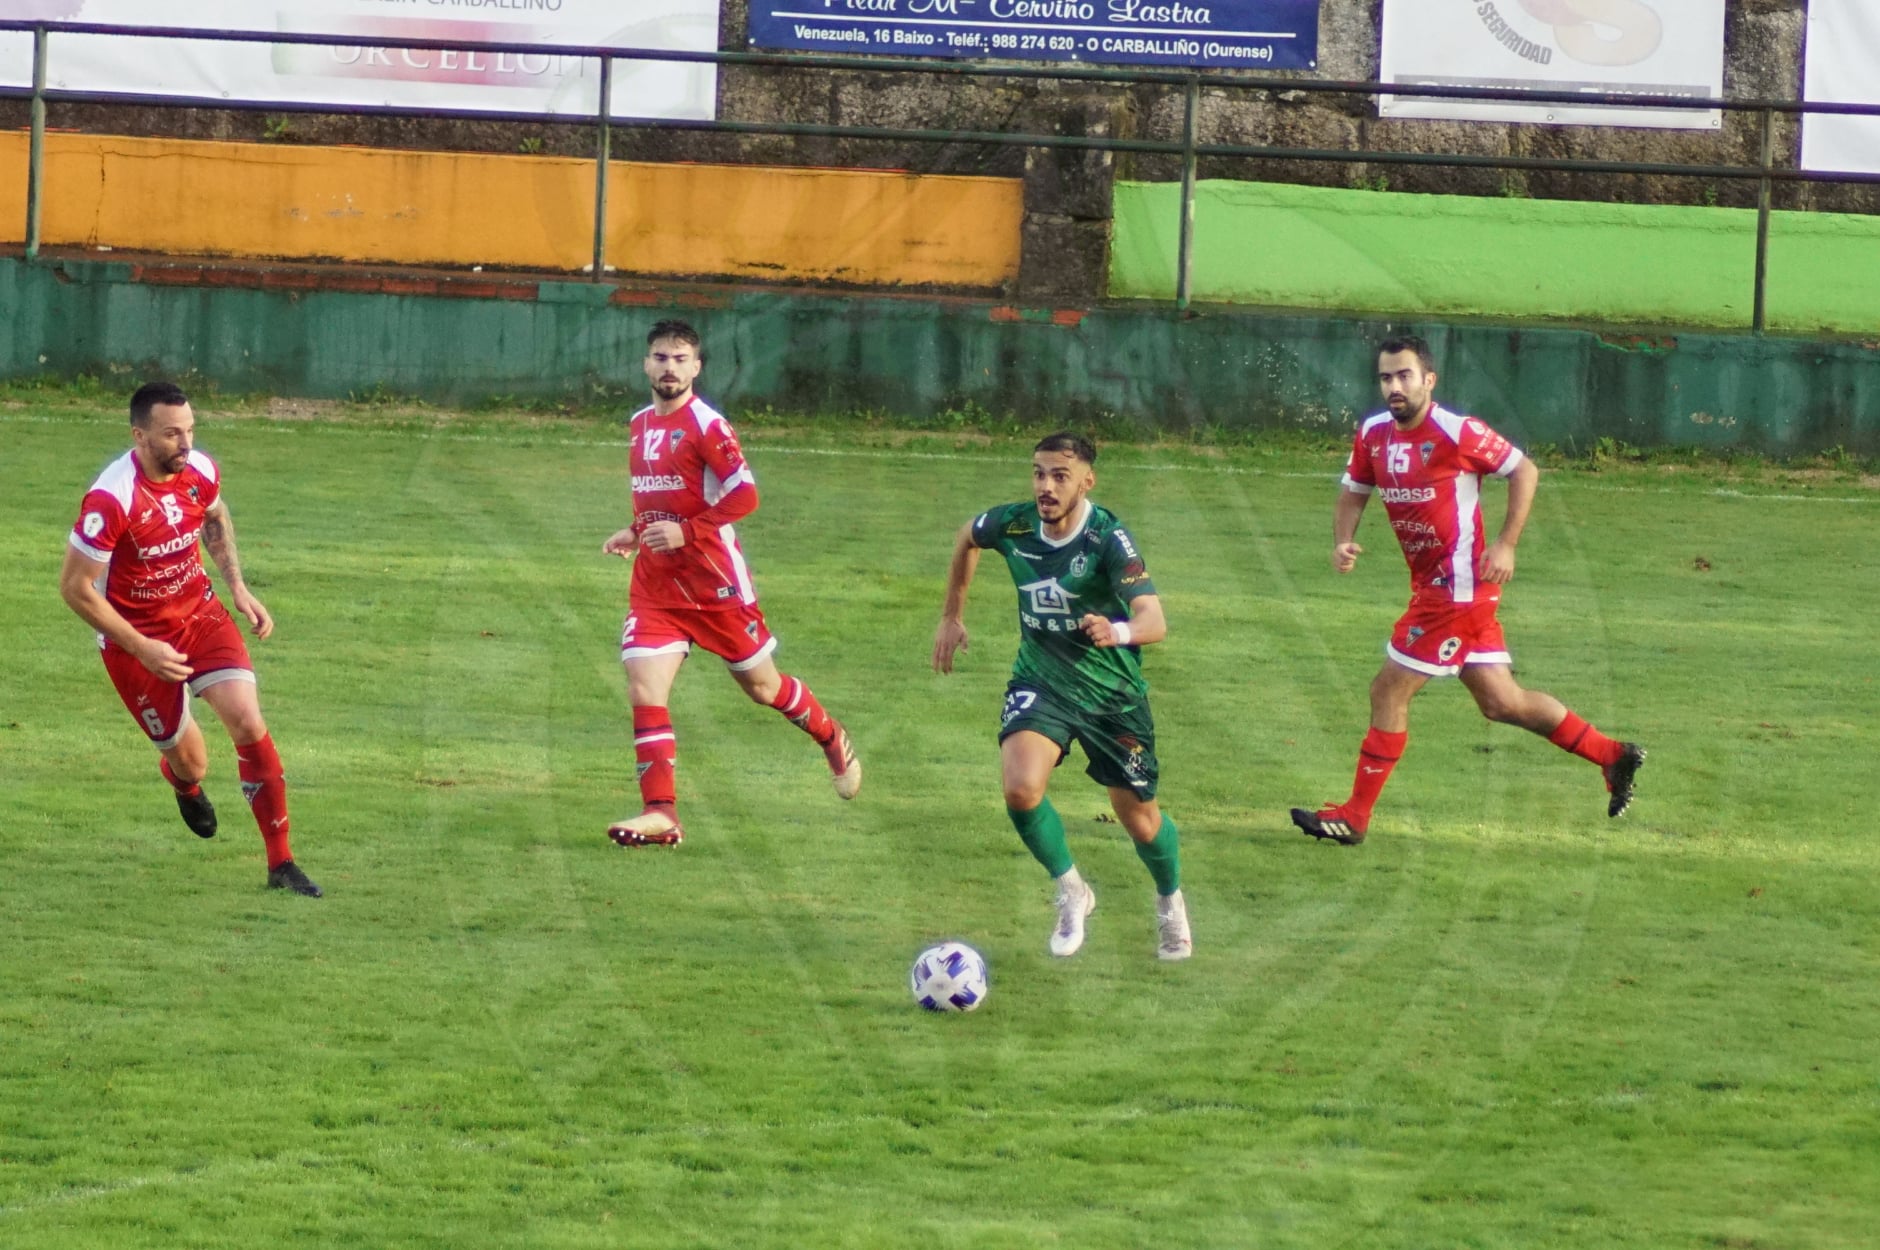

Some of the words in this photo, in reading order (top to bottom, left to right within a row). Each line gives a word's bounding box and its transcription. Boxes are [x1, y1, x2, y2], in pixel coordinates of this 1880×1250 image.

[989, 0, 1094, 19] Cerviño
[1108, 0, 1211, 23] Lastra
[794, 24, 870, 44] Venezuela,
[874, 29, 891, 43] 16
[893, 30, 934, 45] Baixo
[992, 34, 1018, 49] 988
[1020, 35, 1045, 49] 274
[1049, 36, 1074, 50] 620
[1087, 37, 1099, 51] O
[1102, 38, 1200, 56] CARBALLIÑO
[1203, 42, 1273, 62] (Ourense)
[1477, 2, 1553, 65] SEGURIDAD
[643, 429, 666, 460] 12
[1387, 443, 1413, 473] 15
[161, 494, 183, 525] 6
[1377, 486, 1436, 503] ypasa
[1047, 618, 1061, 631] &
[142, 707, 164, 736] 6
